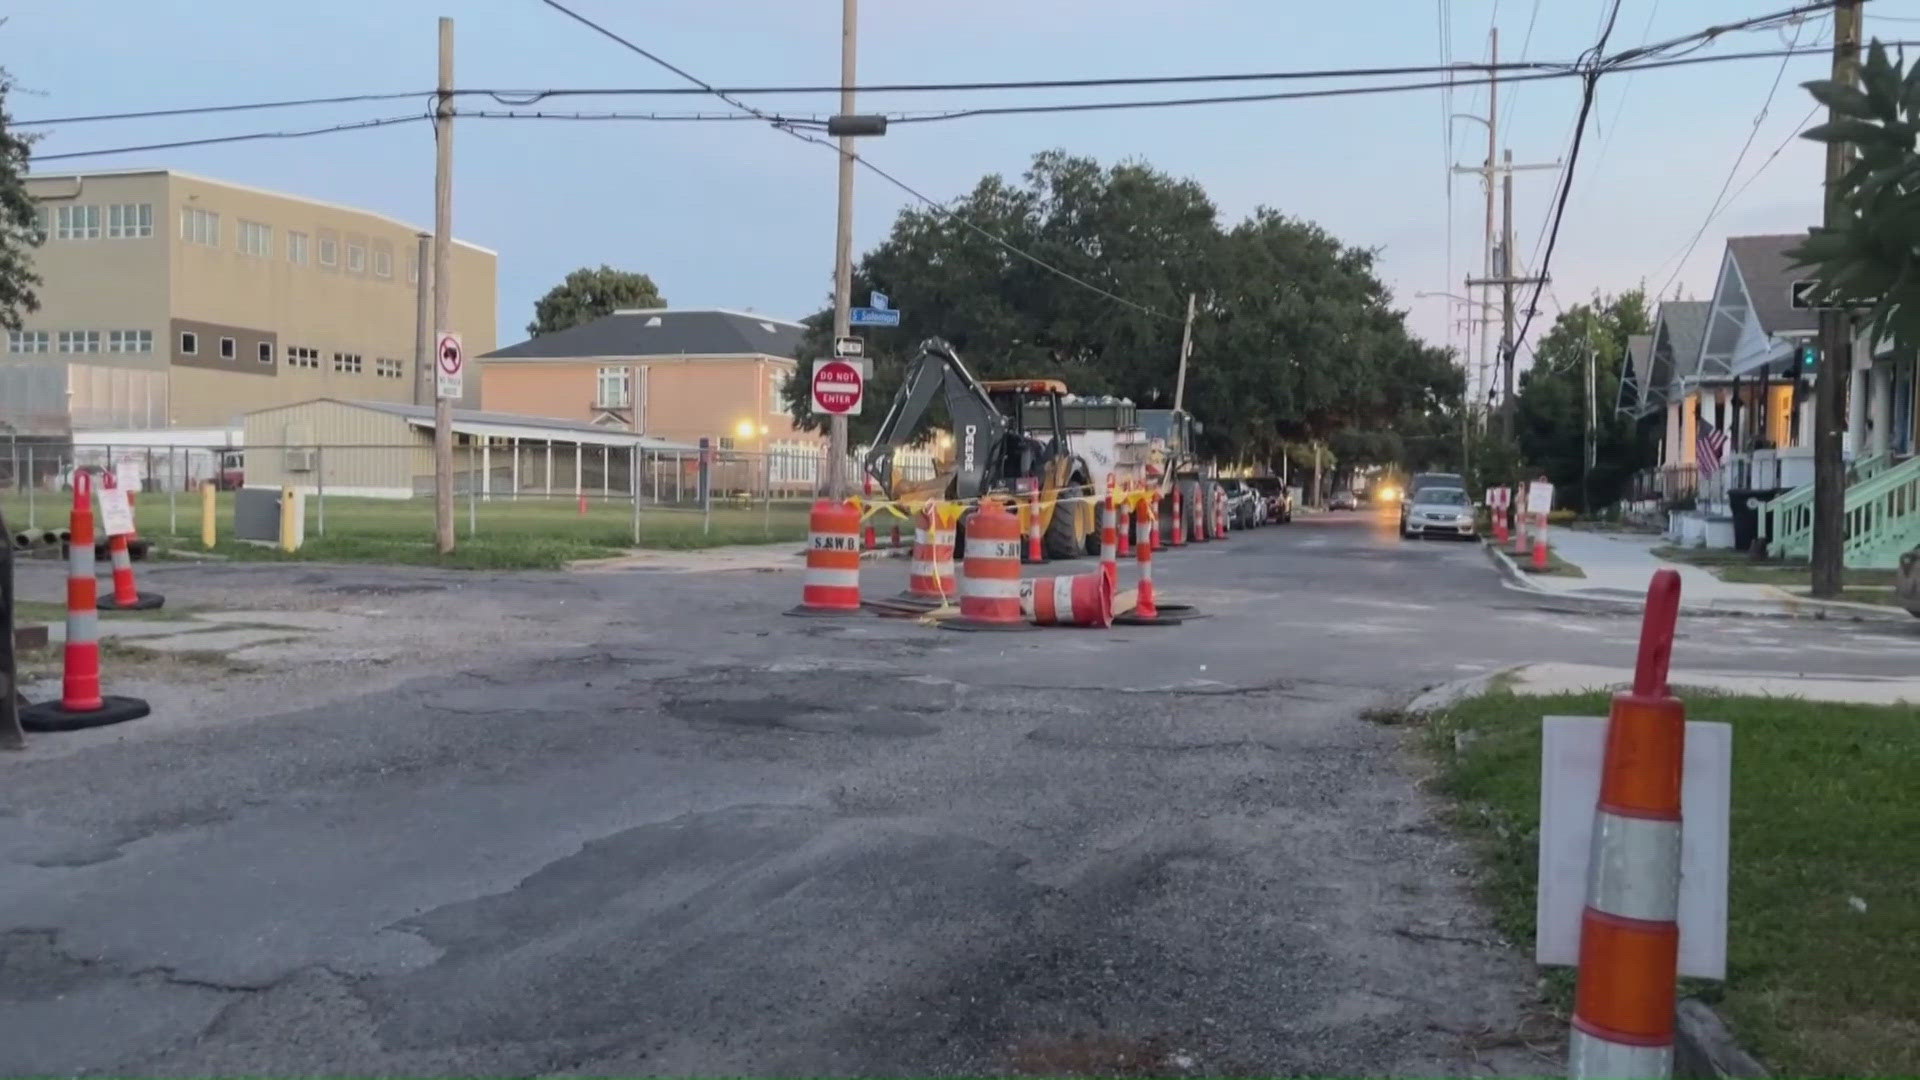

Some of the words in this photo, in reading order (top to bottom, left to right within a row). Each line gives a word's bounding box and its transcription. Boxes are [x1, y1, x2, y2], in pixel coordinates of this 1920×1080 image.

[820, 371, 834, 380] DO
[836, 372, 855, 382] NOT
[822, 393, 851, 404] ENTER
[964, 424, 977, 473] DEERE
